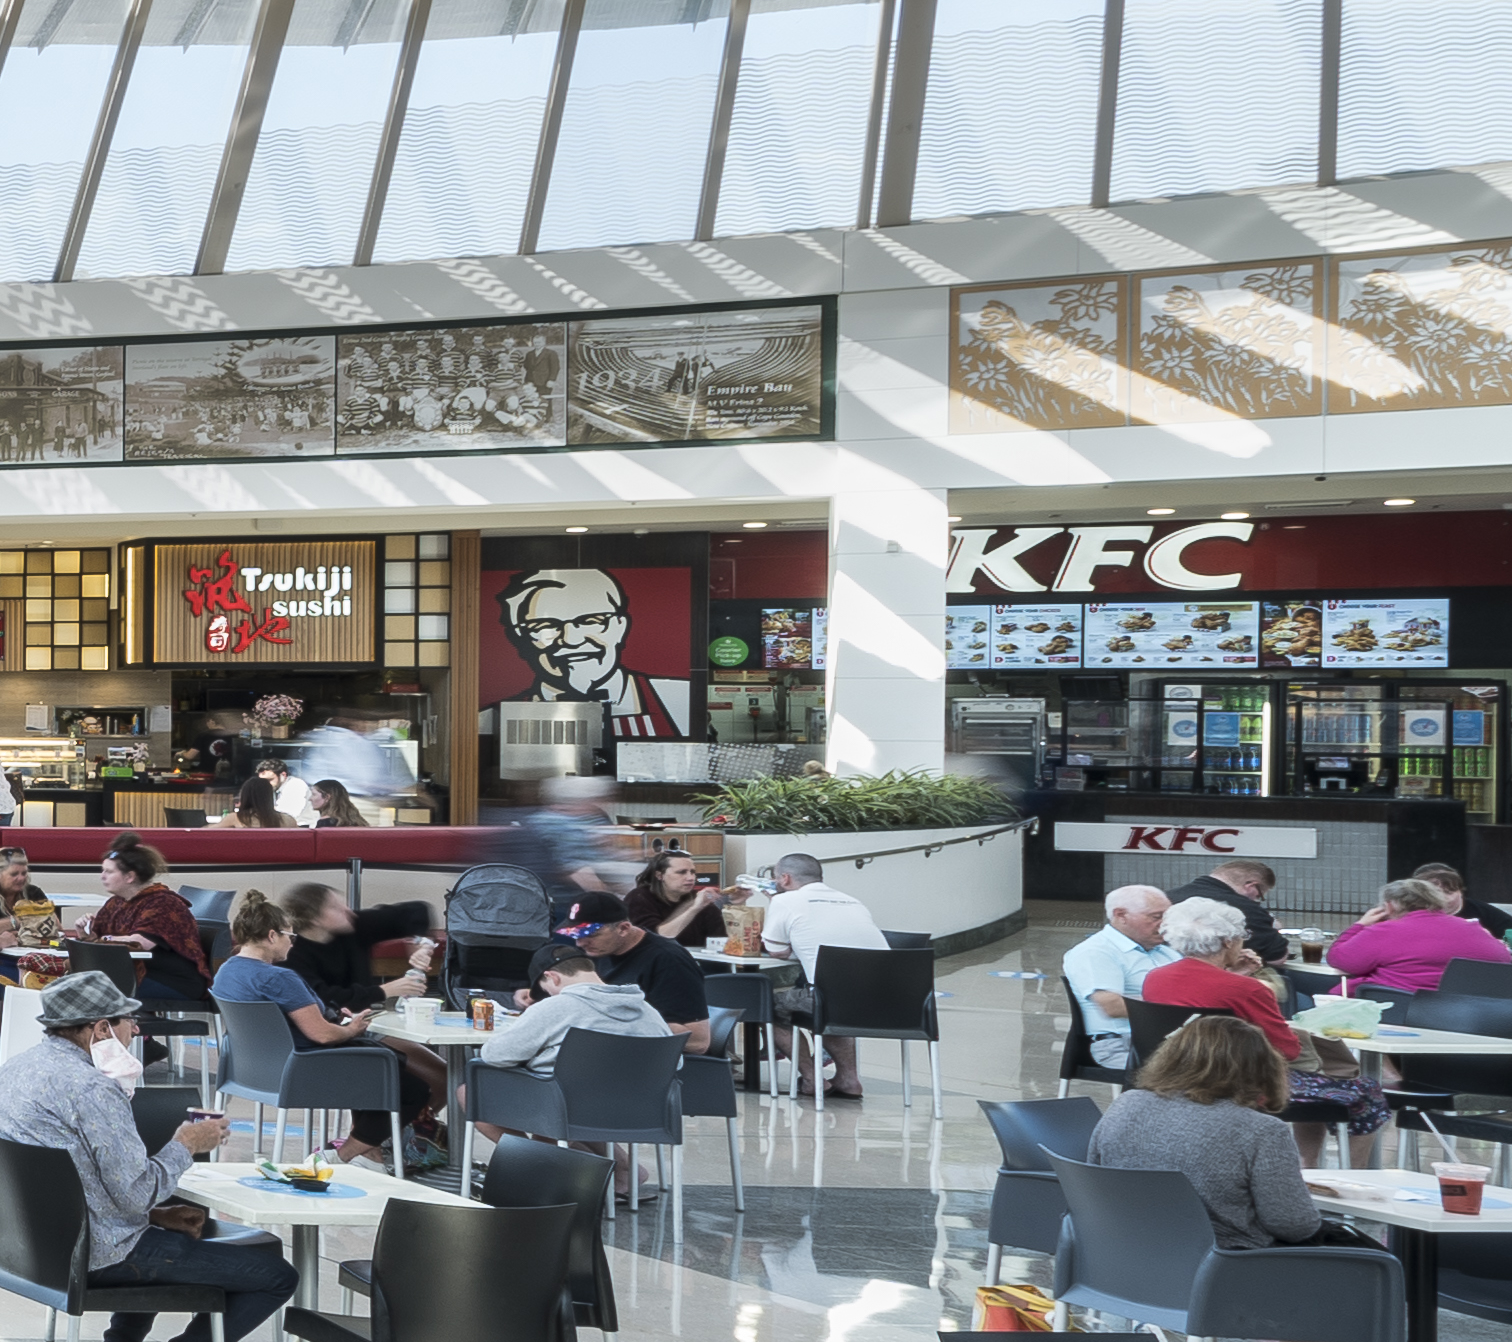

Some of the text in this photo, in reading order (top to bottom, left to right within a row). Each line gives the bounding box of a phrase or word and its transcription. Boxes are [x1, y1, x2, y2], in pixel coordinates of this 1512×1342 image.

[52, 391, 80, 399] GARAGE
[575, 367, 666, 398] 1934
[707, 382, 759, 397] Empire
[948, 522, 1254, 593] KFC
[240, 565, 353, 597] Tsukiji
[272, 597, 352, 617] sushi
[1122, 826, 1239, 853] KFC
